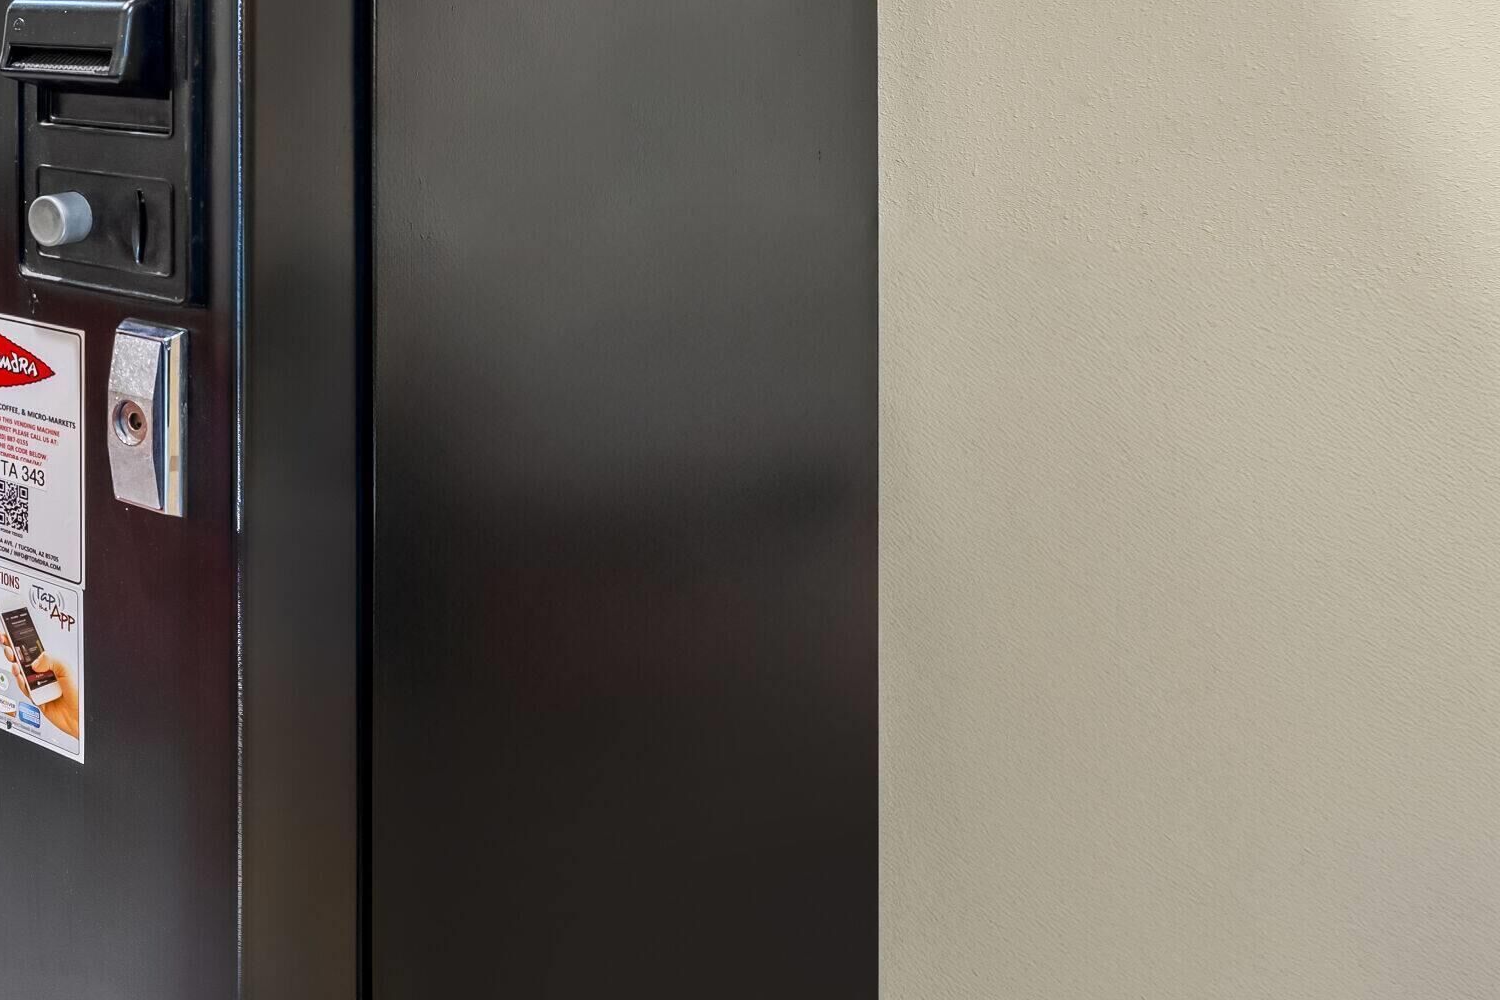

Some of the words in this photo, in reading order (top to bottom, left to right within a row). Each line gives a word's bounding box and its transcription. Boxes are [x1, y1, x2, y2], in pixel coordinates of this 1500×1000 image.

[2, 416, 13, 425] THIS
[14, 419, 36, 431] VENDING
[36, 425, 60, 437] MACHINE
[27, 411, 76, 429] MICRO-MARKETS
[12, 427, 30, 438] PLEASE
[30, 433, 41, 442] CALL
[15, 446, 28, 456] CODE
[29, 449, 47, 460] BELOW
[0, 460, 18, 479] TA
[21, 465, 45, 487] 343
[18, 543, 38, 556] TUCSON,
[32, 584, 55, 610] Tap
